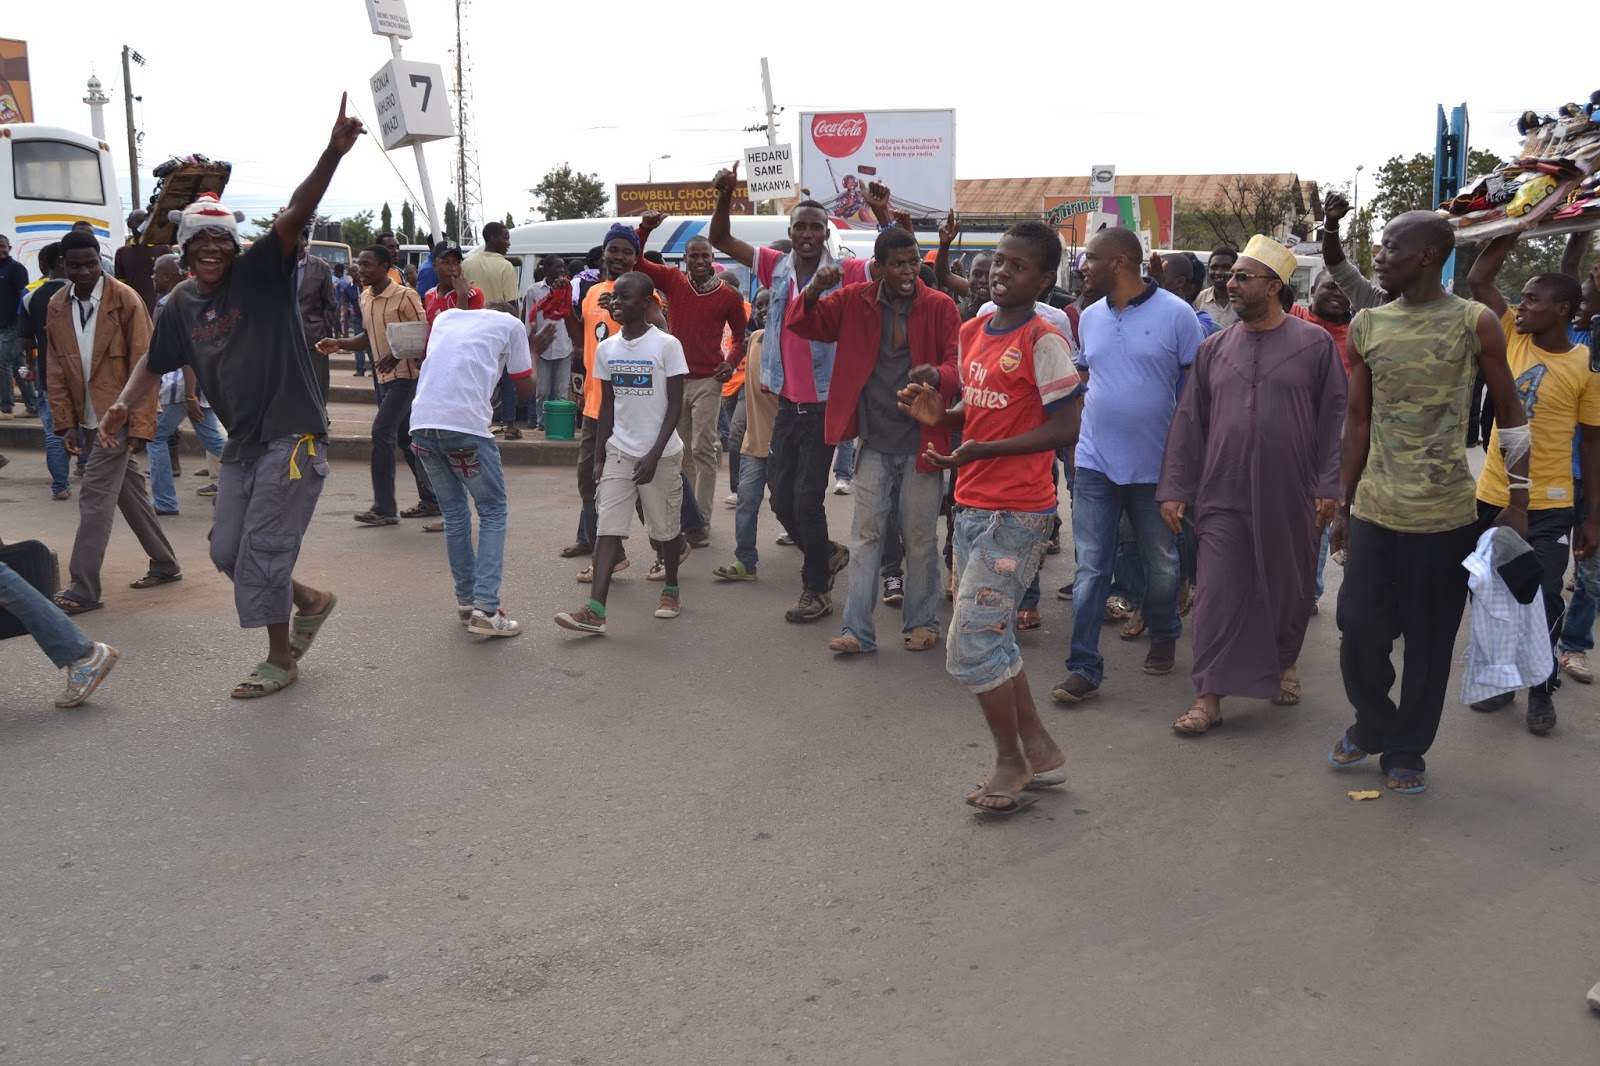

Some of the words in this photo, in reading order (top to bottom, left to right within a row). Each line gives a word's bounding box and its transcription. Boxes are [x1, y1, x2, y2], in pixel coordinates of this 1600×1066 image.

[373, 72, 389, 93] GONJA
[409, 74, 432, 113] 7
[813, 119, 864, 137] Coca-Cola
[748, 150, 789, 163] HEDARU
[754, 165, 783, 176] SAME
[750, 180, 791, 193] MAKANYA
[621, 190, 675, 201] COWBELL
[678, 188, 749, 199] CHOCOATE
[645, 201, 680, 211] YENYE
[683, 200, 716, 210] LADH
[969, 361, 988, 386] Fly
[962, 382, 1009, 409] irates
